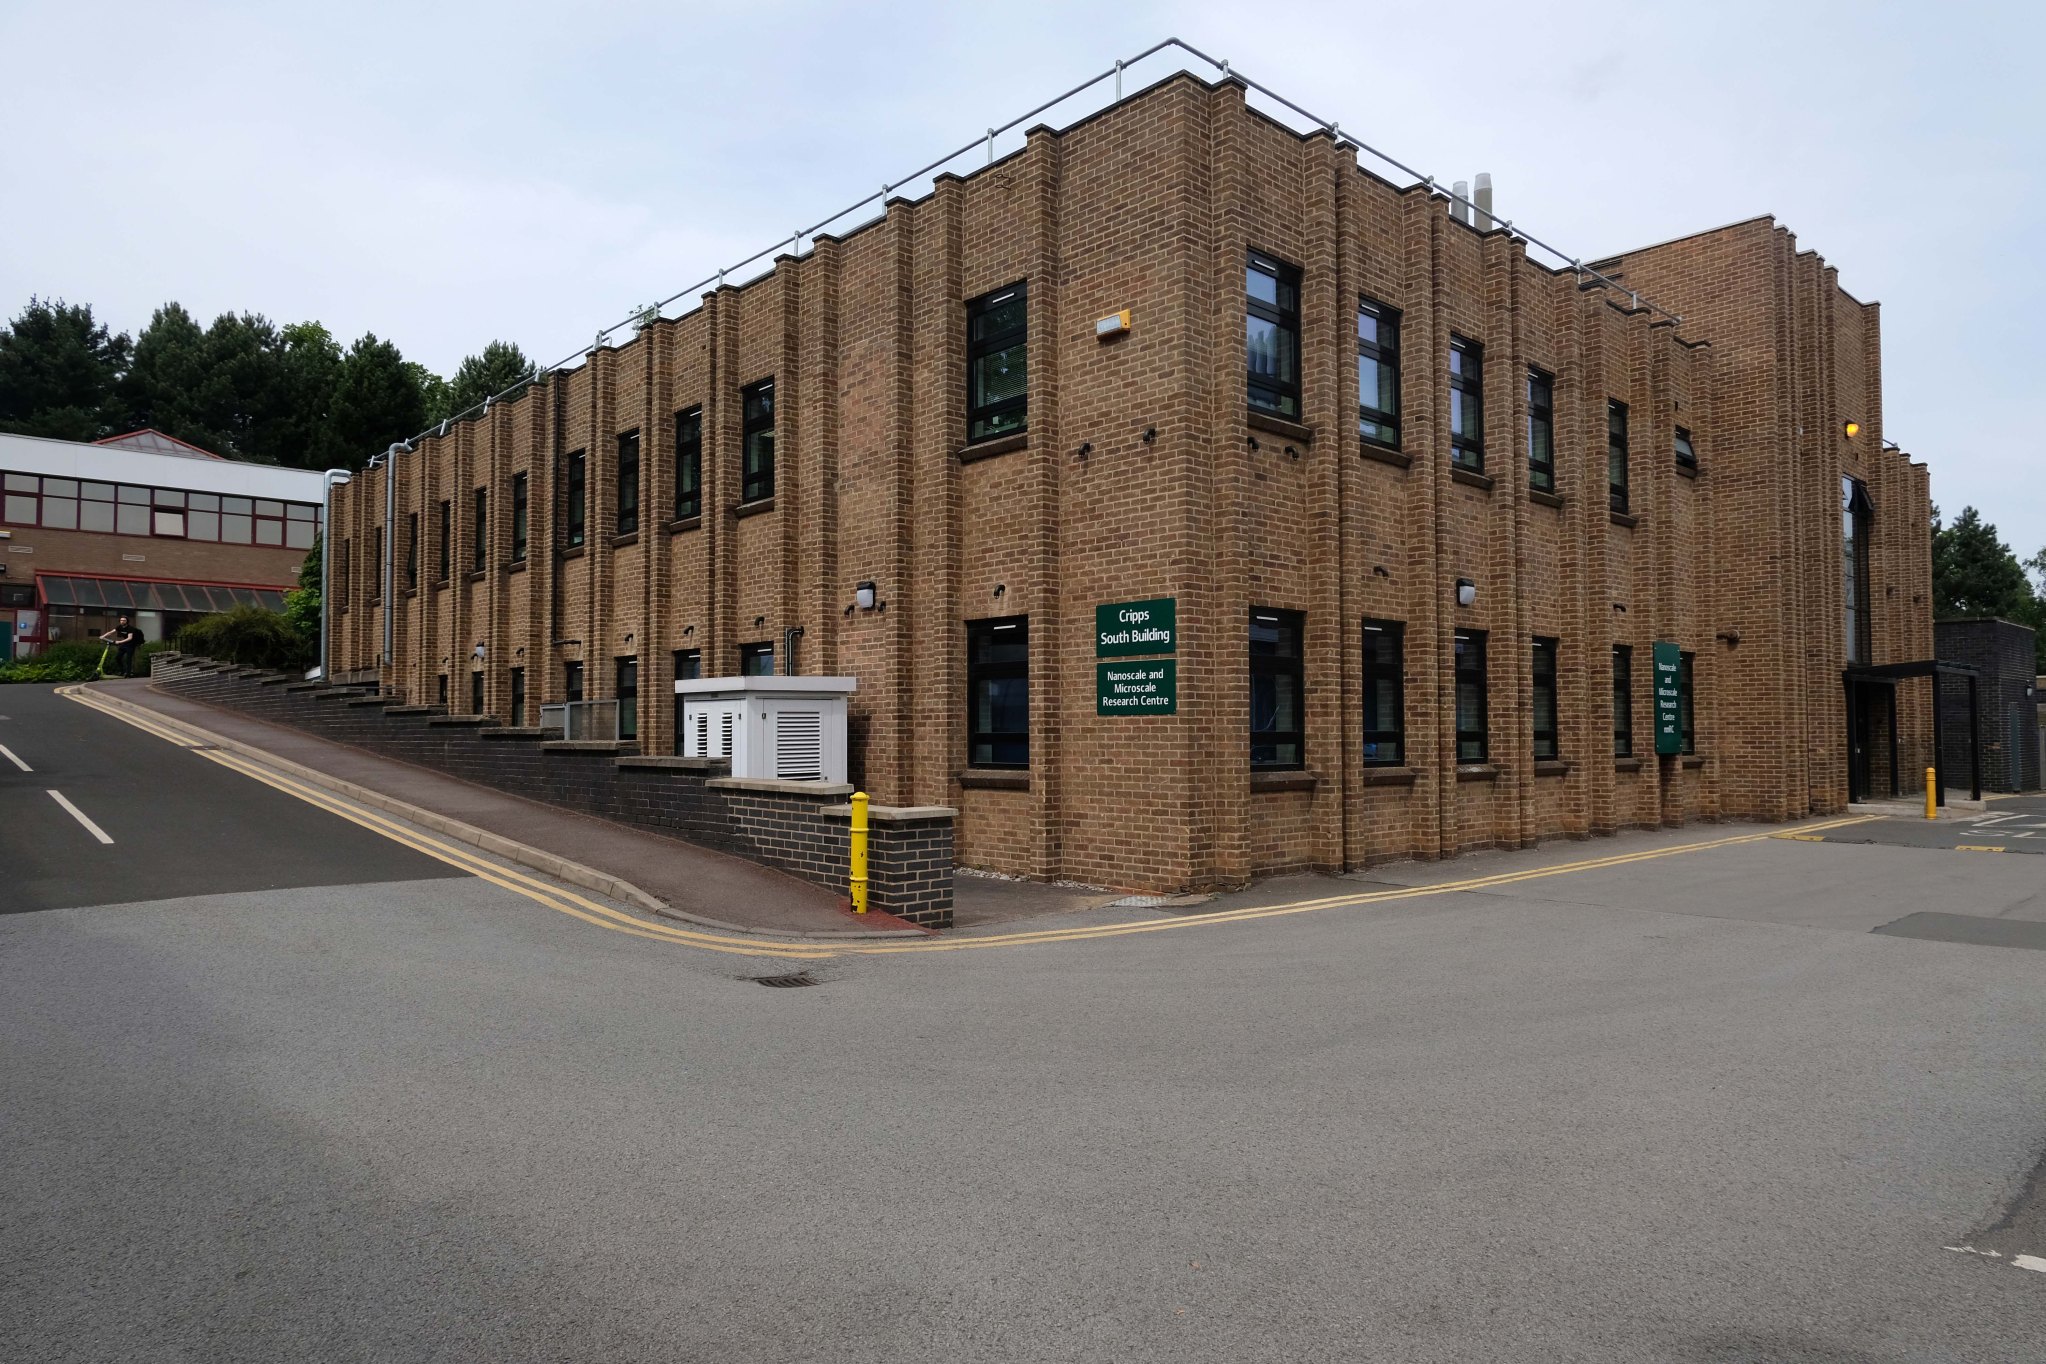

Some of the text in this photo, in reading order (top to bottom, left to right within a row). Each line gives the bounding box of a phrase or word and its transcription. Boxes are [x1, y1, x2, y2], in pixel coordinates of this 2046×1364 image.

[1119, 609, 1149, 624] Cripps
[1101, 628, 1170, 645] South Building
[1658, 663, 1676, 671] Nanoscale
[1107, 668, 1164, 681] Nanoscale and
[1114, 682, 1156, 693] Microscale
[1658, 688, 1677, 697] Microscale
[1102, 695, 1169, 706] Research Centre
[1660, 700, 1677, 709] Research
[1662, 713, 1675, 721] Centre
